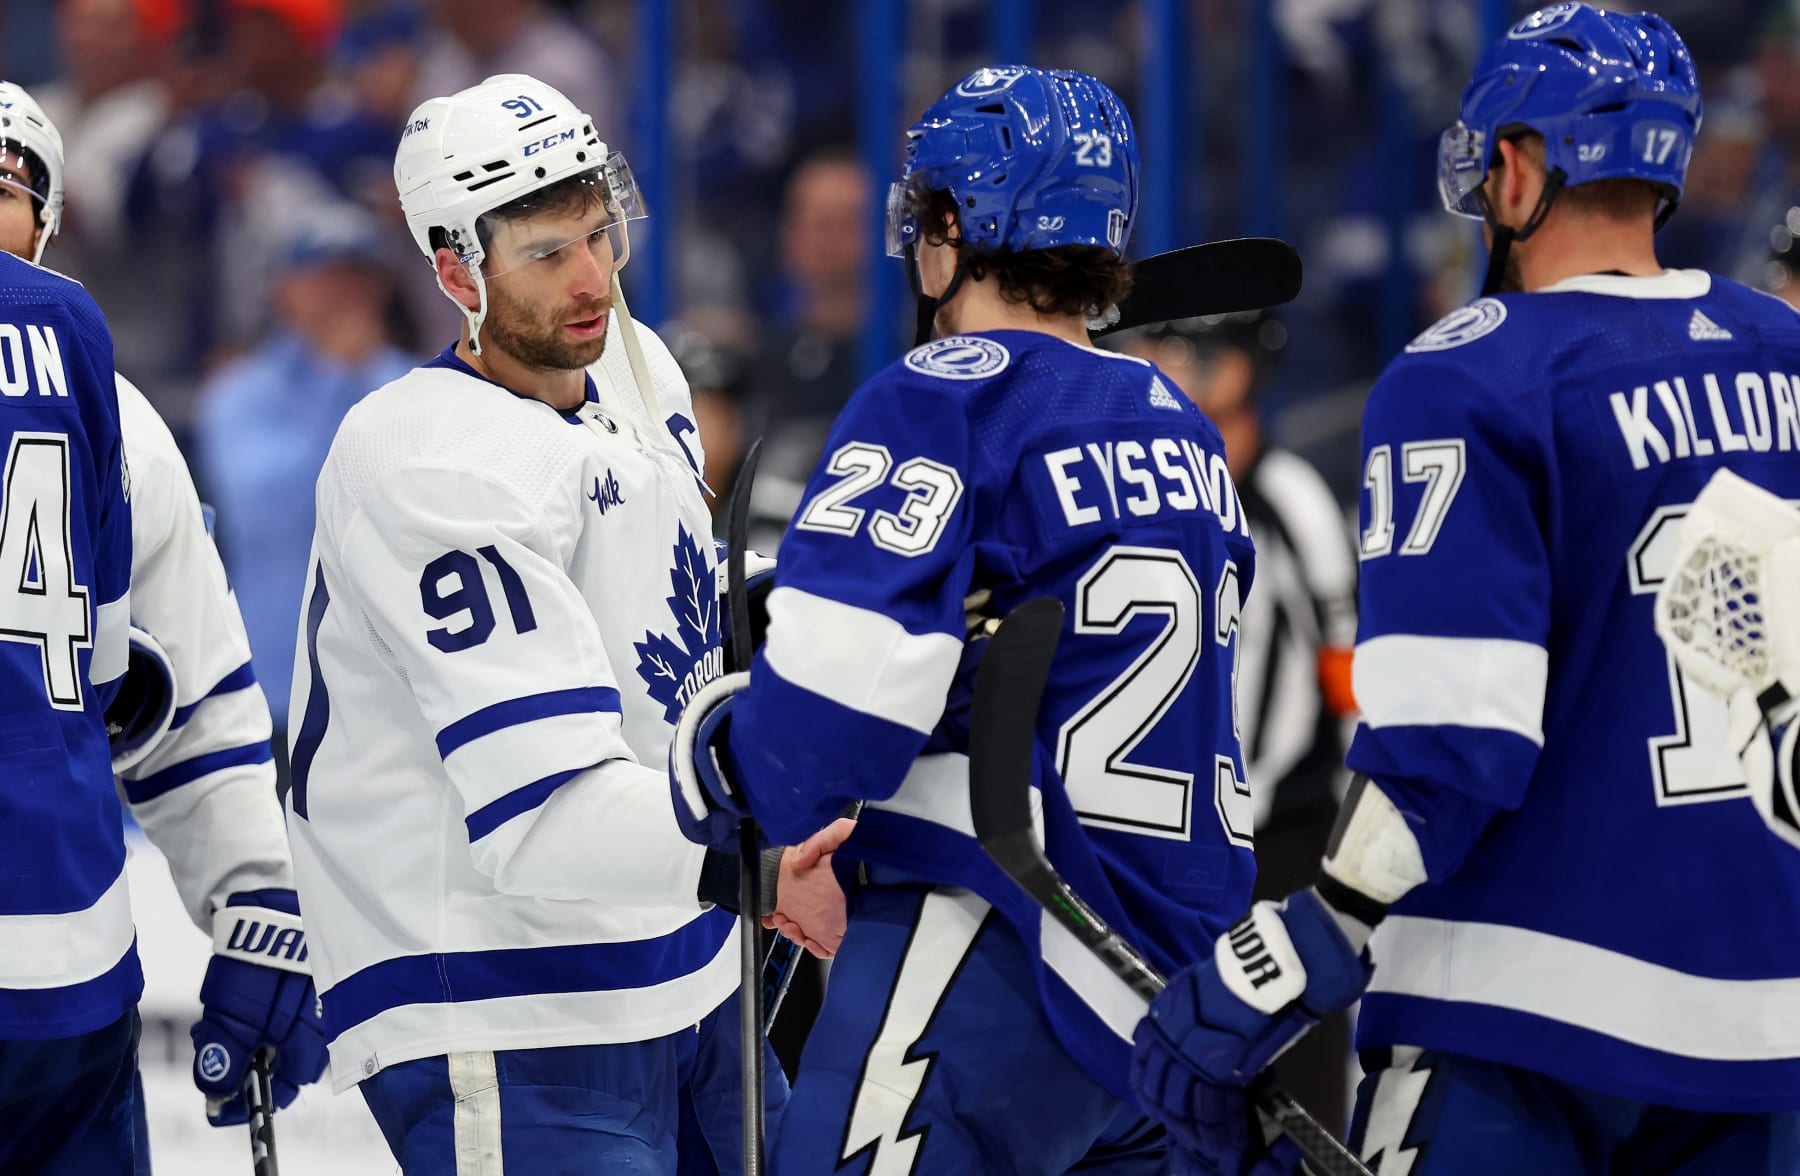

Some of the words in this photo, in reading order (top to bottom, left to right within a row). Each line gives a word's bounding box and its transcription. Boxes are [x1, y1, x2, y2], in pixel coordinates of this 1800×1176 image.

[502, 95, 543, 118] 91
[523, 128, 575, 157] CCM
[1074, 134, 1112, 167] 23
[1643, 129, 1677, 165] 17
[0, 324, 68, 397] ON
[1609, 371, 1800, 470] KILLOR
[796, 441, 964, 557] 23
[1359, 438, 1466, 561] 17
[419, 544, 537, 653] 91
[227, 918, 309, 962] WA
